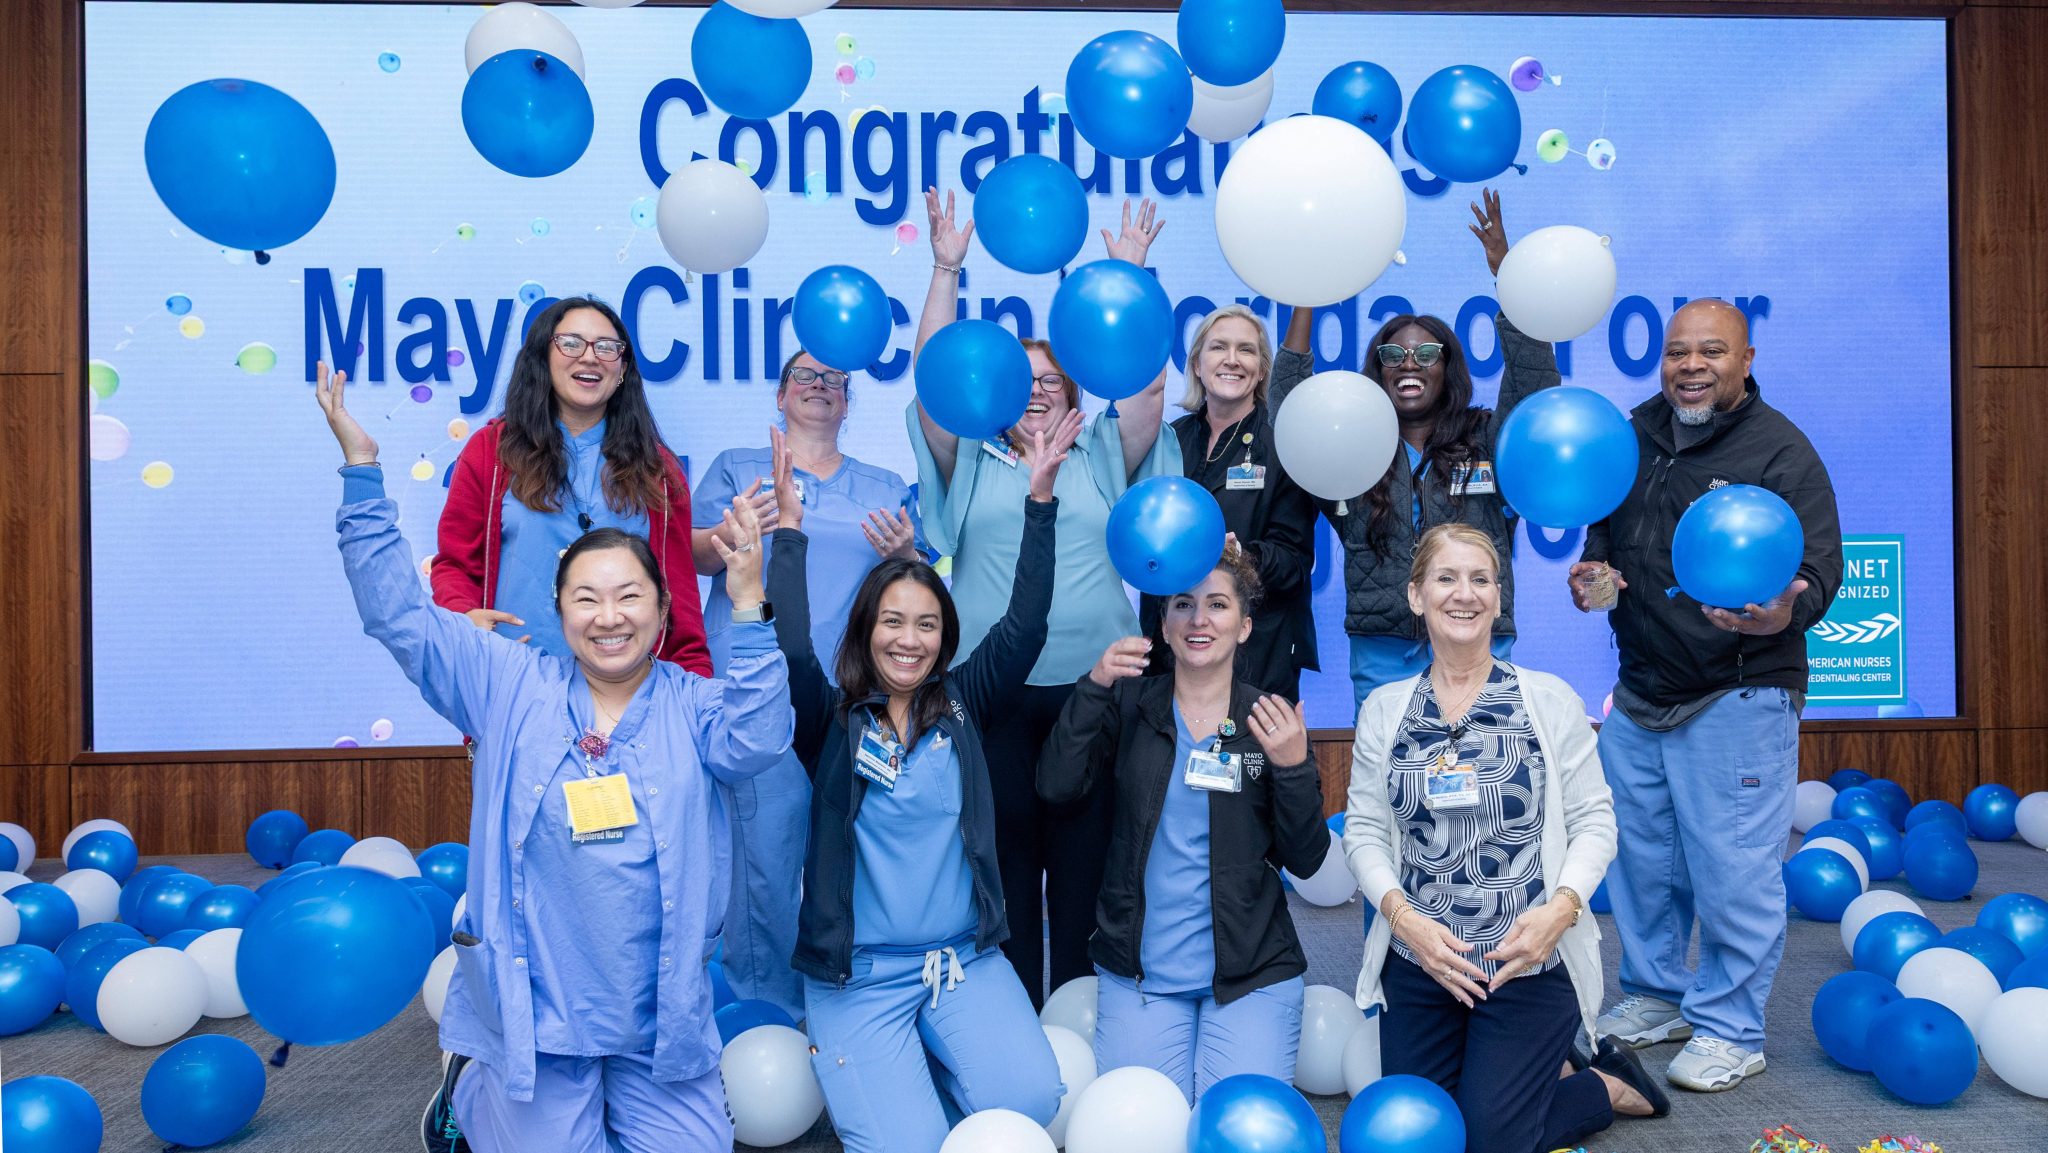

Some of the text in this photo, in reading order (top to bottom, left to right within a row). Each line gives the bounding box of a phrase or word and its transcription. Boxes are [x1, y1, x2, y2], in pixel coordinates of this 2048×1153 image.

[304, 268, 562, 414] May
[1808, 656, 1891, 669] MERICAN NURSES
[1862, 673, 1891, 683] CENTER
[857, 763, 881, 781] Registered
[881, 775, 894, 790] Nurse
[572, 830, 623, 843] Registered Nurse
